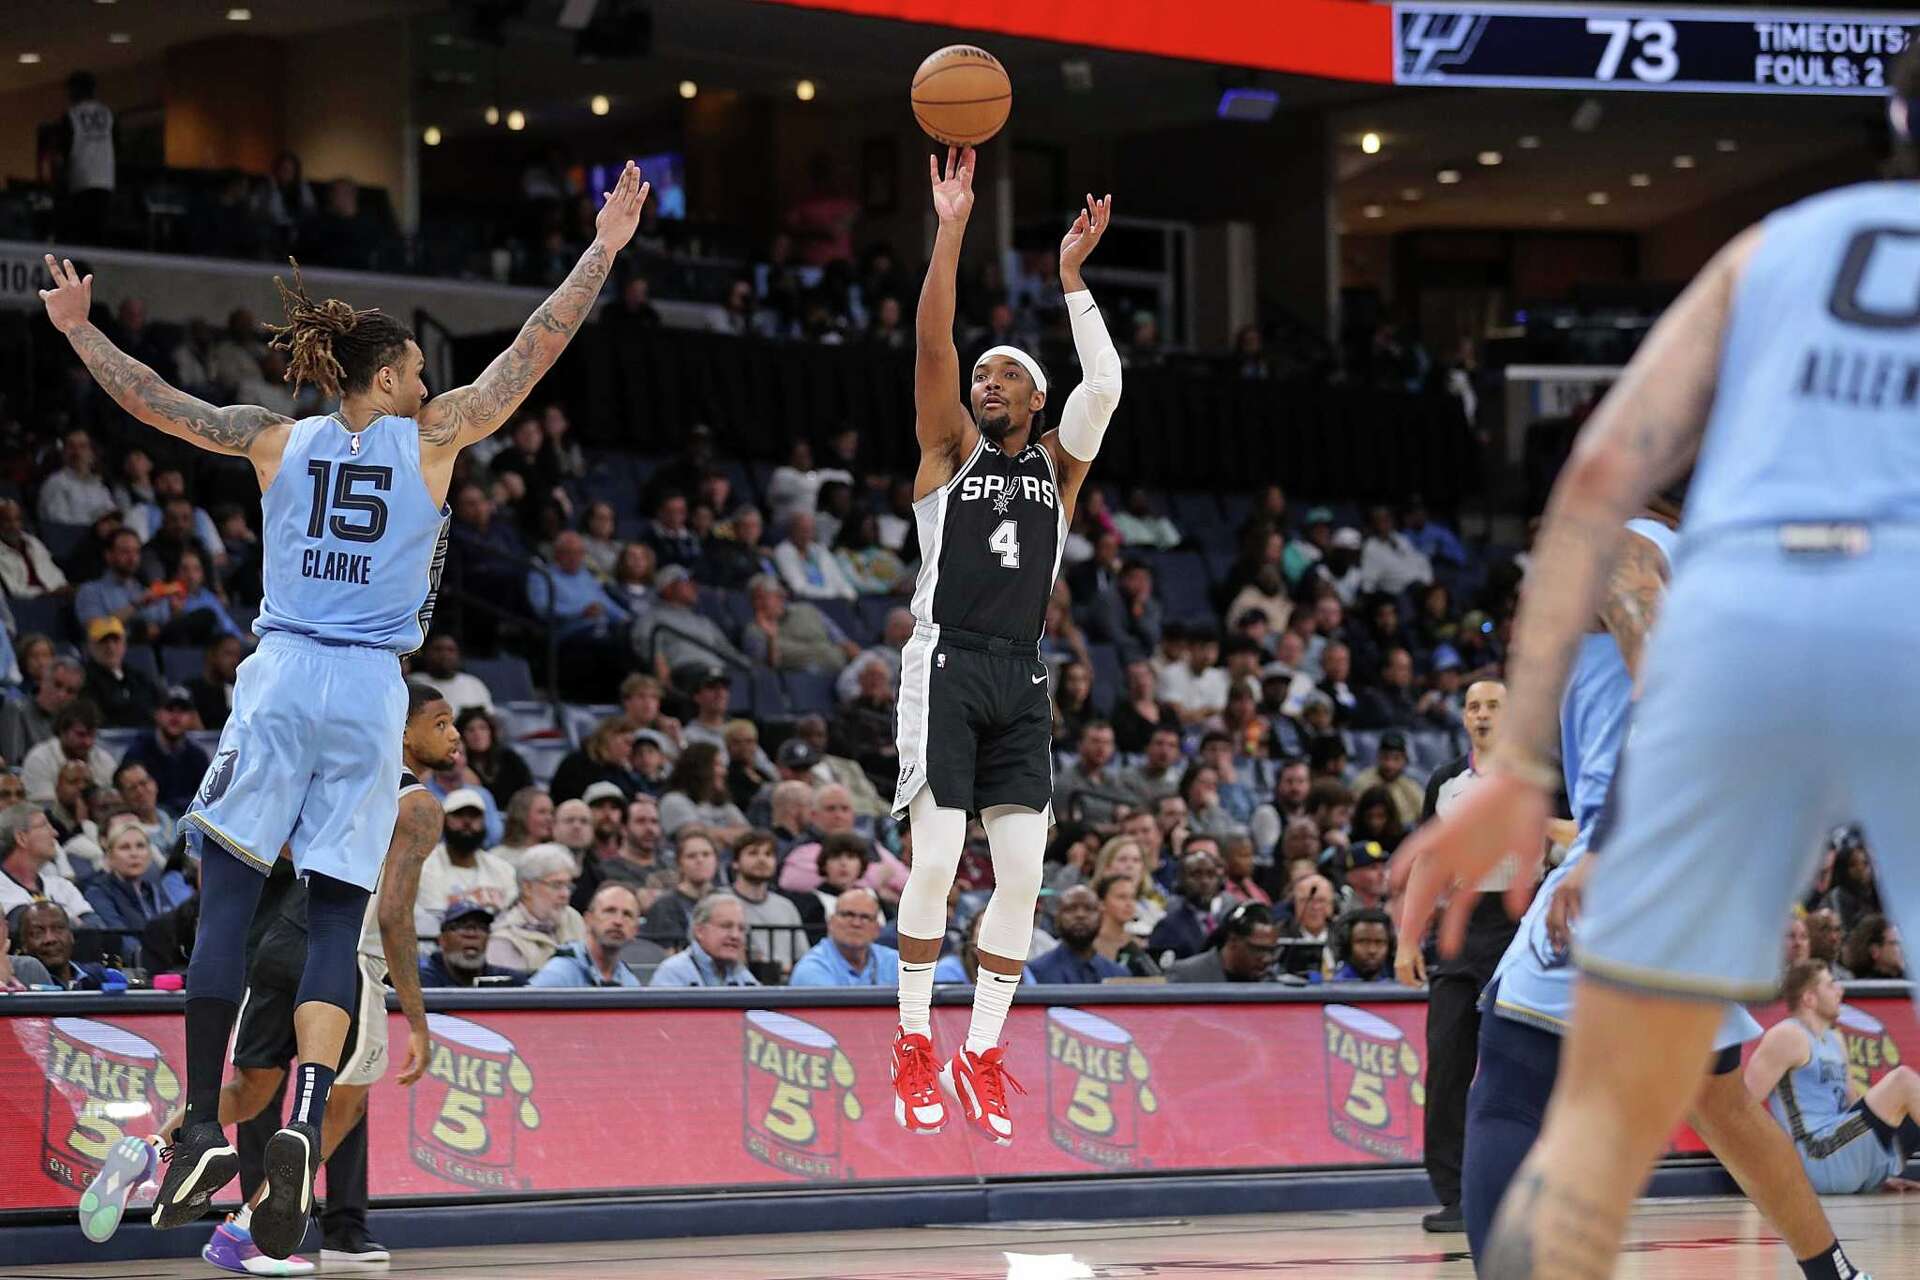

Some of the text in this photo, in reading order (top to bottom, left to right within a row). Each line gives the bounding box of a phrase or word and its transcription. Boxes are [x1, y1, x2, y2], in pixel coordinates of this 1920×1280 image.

[1586, 18, 1680, 82] 73
[1754, 22, 1911, 54] TIMEOUTS:
[1755, 54, 1884, 87] FOULS: 2
[307, 459, 393, 543] 15
[961, 475, 1055, 513] SPURS
[301, 549, 373, 585] CLARKE
[989, 519, 1020, 569] 4
[50, 1036, 149, 1101] TAKE
[429, 1039, 506, 1097] AKE
[746, 1028, 829, 1089] TAKE
[1049, 1023, 1125, 1083] TAKE
[1325, 1021, 1397, 1078] TAKE
[432, 1087, 488, 1151] 5
[763, 1081, 816, 1143] 5
[1067, 1074, 1115, 1134] 5
[1344, 1069, 1389, 1127] 5
[67, 1096, 125, 1161] 5
